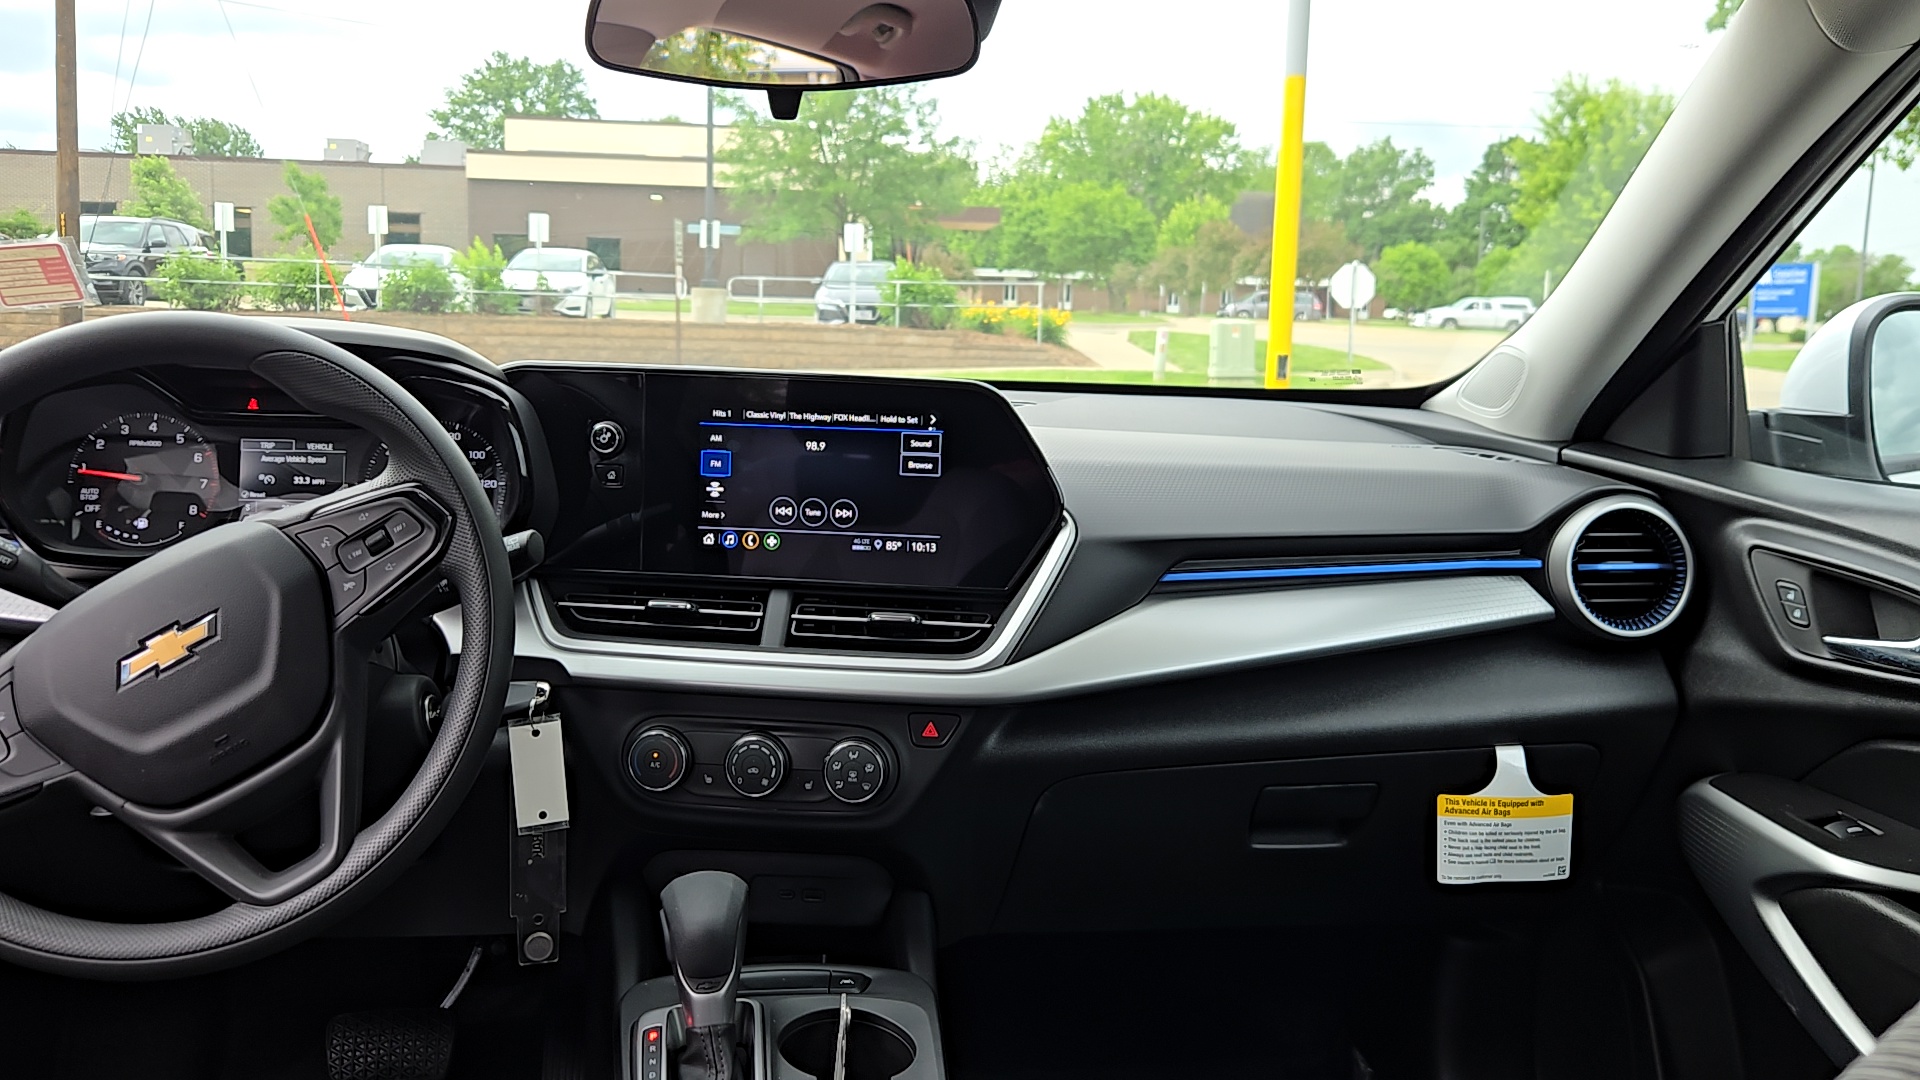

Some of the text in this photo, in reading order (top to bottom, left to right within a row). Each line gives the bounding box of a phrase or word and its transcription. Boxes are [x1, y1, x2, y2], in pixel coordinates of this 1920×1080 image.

[746, 410, 786, 421] Classic Vinyl
[803, 413, 832, 422] Highway
[880, 415, 897, 423] Hold
[120, 424, 130, 435] 3
[148, 422, 158, 432] 4
[176, 433, 185, 444] 5
[710, 434, 723, 443] AM
[95, 439, 105, 450] 2
[805, 441, 826, 451] 98.9
[910, 439, 932, 448] Sound
[193, 452, 203, 463] 6
[261, 455, 286, 464] Average
[307, 456, 326, 464] Speed
[469, 451, 486, 460] 100
[710, 460, 722, 468] FM
[908, 461, 933, 470] Browse
[200, 478, 209, 489] 7
[293, 476, 310, 485] 33.3
[481, 479, 498, 489] 120
[188, 504, 198, 515] 8
[805, 508, 821, 517] Tune
[701, 510, 720, 519] More
[96, 520, 103, 528] E
[178, 521, 186, 529] F
[911, 542, 937, 553] 10:13
[1498, 800, 1529, 808] Equipped
[1444, 807, 1480, 815] Advanced
[1494, 808, 1511, 817] Bags
